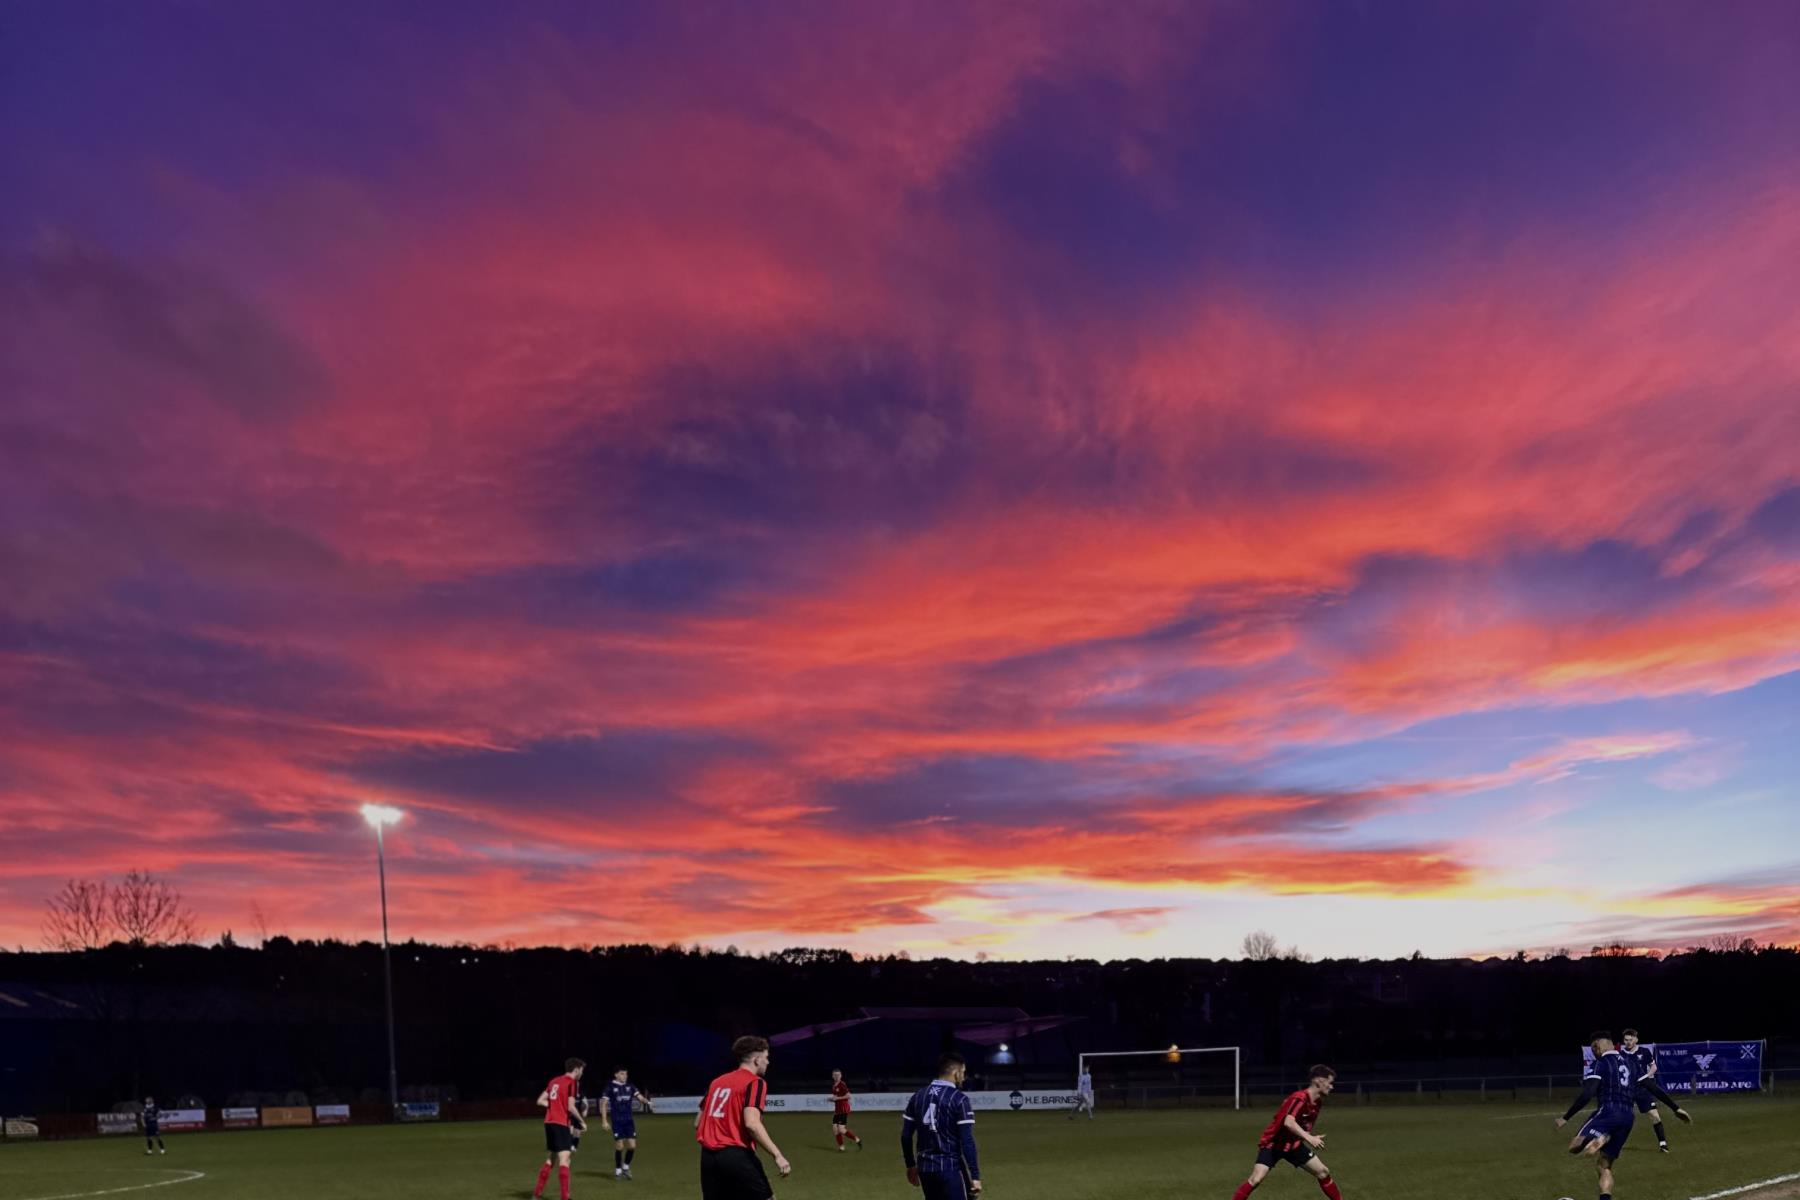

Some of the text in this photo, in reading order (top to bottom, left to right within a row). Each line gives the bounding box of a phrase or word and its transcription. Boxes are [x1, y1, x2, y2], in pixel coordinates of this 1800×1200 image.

[1659, 1049, 1671, 1057] WE
[1618, 1064, 1630, 1087] 3
[1730, 1081, 1752, 1089] AFC
[549, 1083, 559, 1100] 8
[711, 1087, 731, 1118] 12
[922, 1103, 938, 1132] 4
